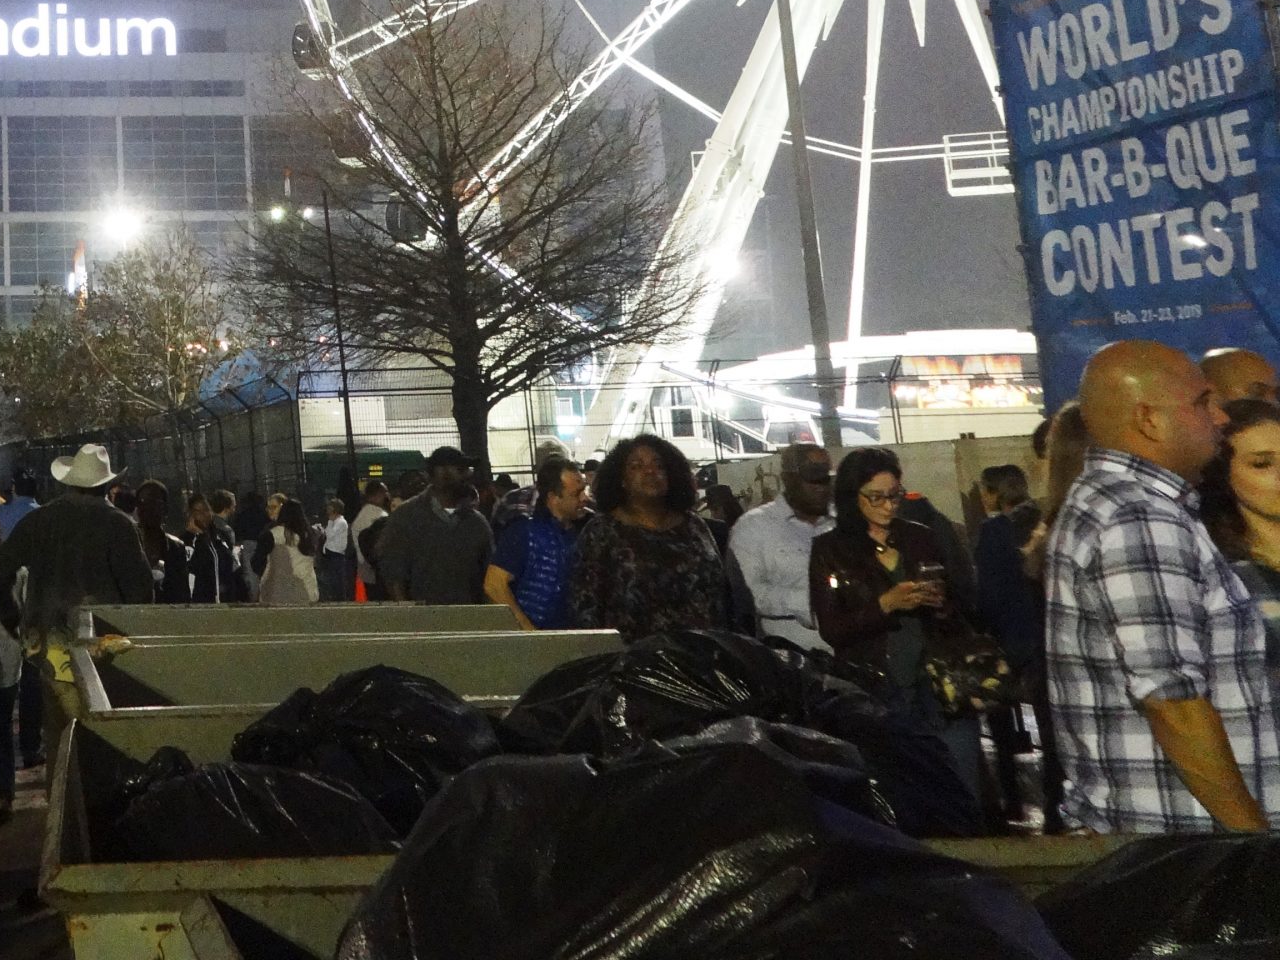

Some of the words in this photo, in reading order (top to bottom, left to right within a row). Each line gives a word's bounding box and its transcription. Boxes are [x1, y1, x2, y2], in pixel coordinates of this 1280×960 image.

[1027, 48, 1245, 144] CHAMPIONSHIP
[1035, 109, 1258, 216] BAR-B-QUE
[1040, 192, 1260, 297] CONTEST
